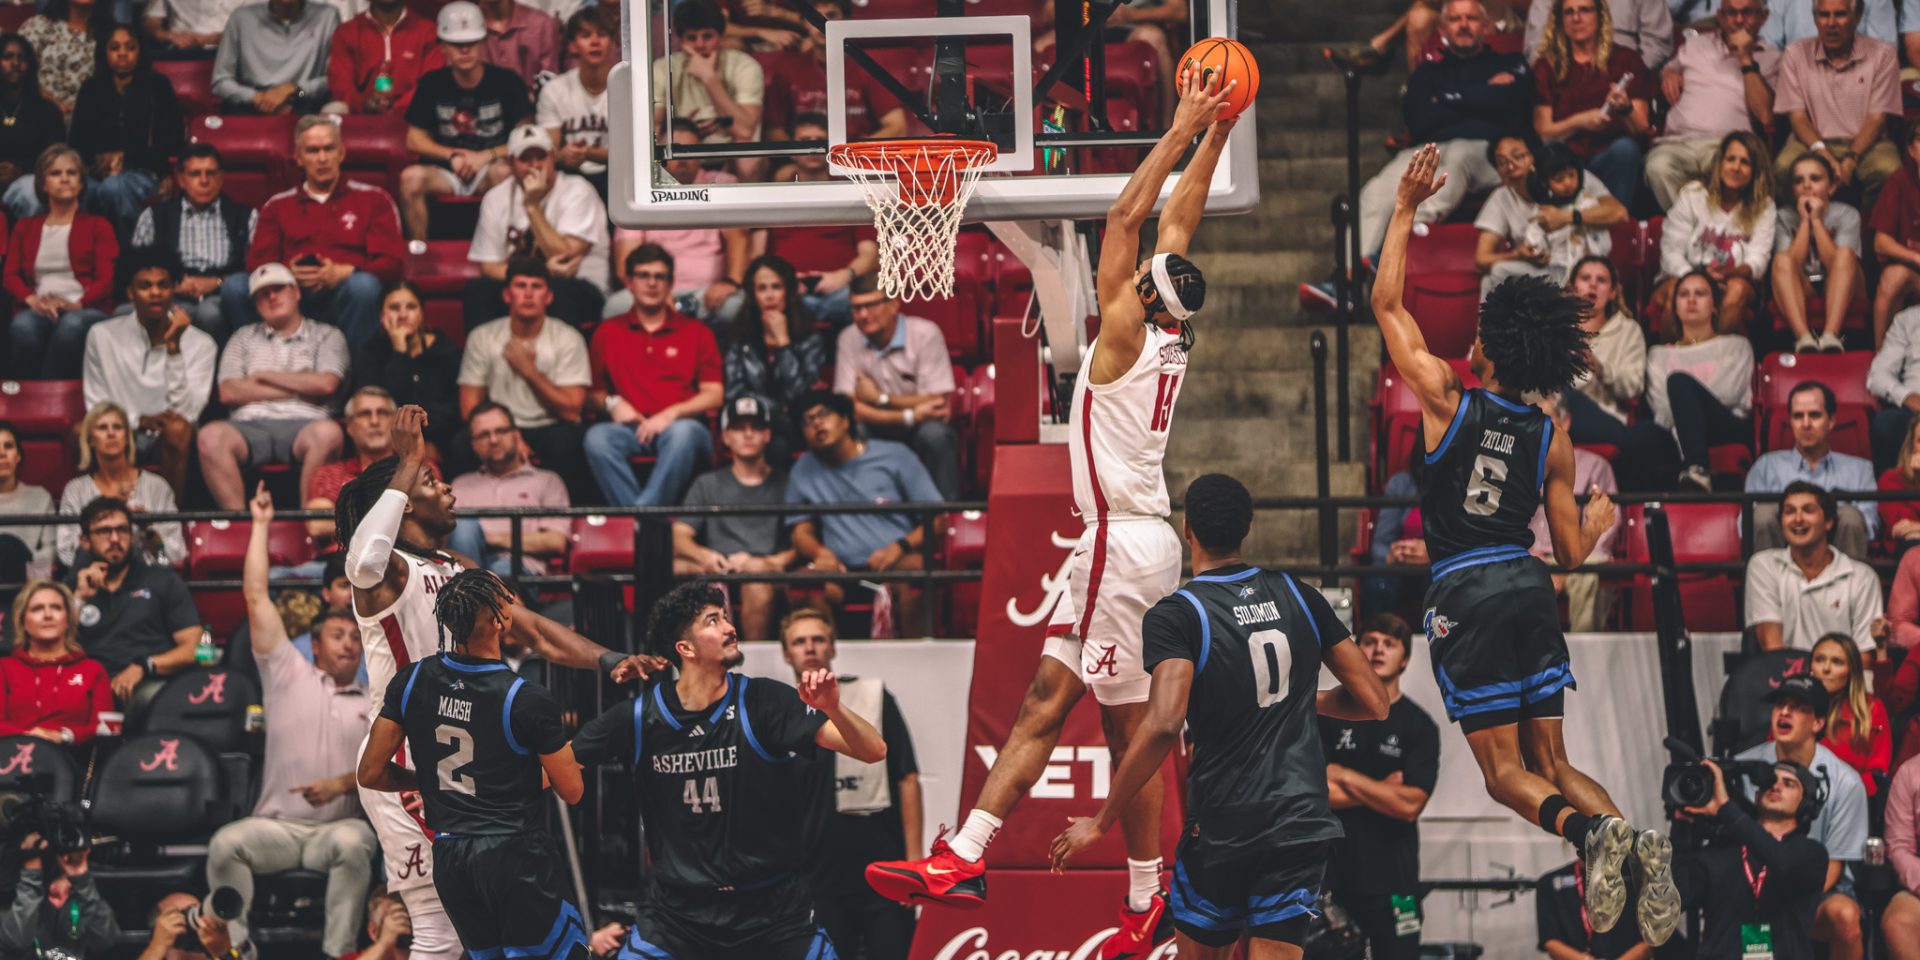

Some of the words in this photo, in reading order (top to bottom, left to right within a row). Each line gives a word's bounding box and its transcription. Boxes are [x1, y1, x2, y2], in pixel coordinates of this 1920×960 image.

[651, 189, 710, 203] SPALDING
[1151, 373, 1179, 432] 15
[1480, 428, 1516, 455] TAYLOR
[1463, 453, 1509, 516] 6
[1233, 600, 1281, 626] SOLOMON
[1248, 628, 1293, 709] 0
[437, 695, 472, 722] MARSH
[434, 723, 477, 797] 2
[652, 745, 738, 774] ASHEVILLE
[683, 776, 722, 814] 44
